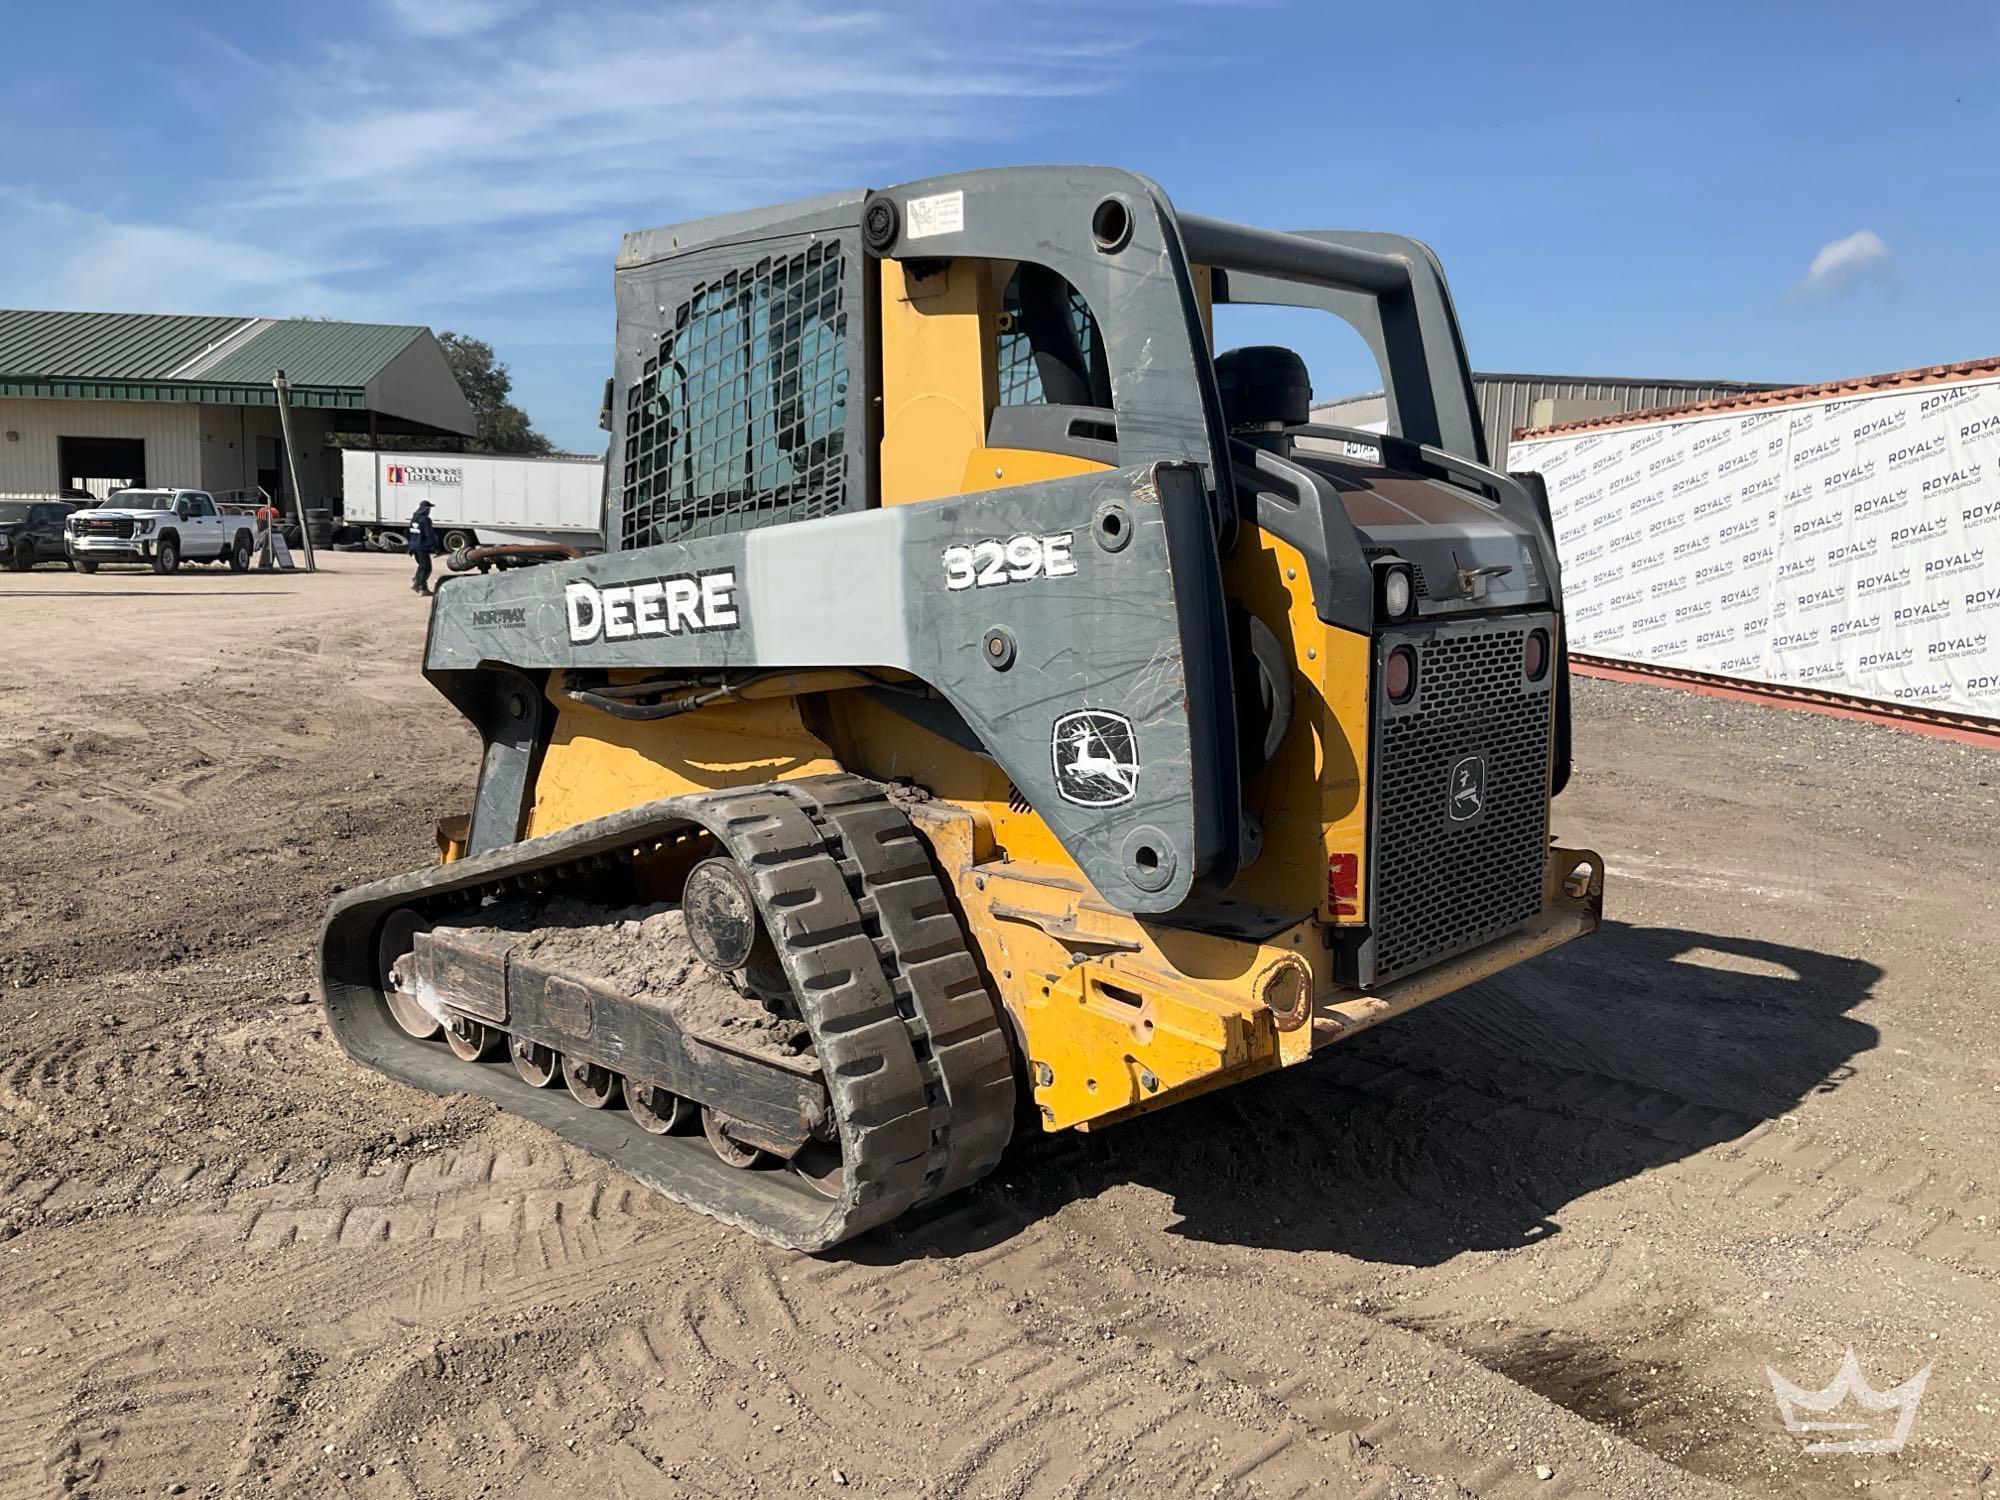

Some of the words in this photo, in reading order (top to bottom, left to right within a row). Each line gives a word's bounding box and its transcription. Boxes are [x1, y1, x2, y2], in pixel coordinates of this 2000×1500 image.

[1920, 387, 1967, 412] ROYAL
[1921, 403, 1953, 419] AUCTION
[1954, 392, 1980, 407] GROUP
[1853, 416, 1894, 439] ROYAL
[1961, 416, 2000, 438] ROYA
[1630, 434, 1656, 451] ROYAL
[1692, 432, 1722, 452] ROYAL
[1962, 430, 1995, 446] AUCTION
[1793, 441, 1830, 463] ROYAL
[1888, 441, 1933, 464] ROYAL
[1889, 456, 1920, 472] AUCTION
[1920, 447, 1946, 462] GROUP
[1592, 455, 1617, 470] ROYAL
[1649, 455, 1675, 472] ROYAL
[1718, 454, 1749, 472] ROYAL
[1609, 475, 1634, 490] ROYAL
[1672, 477, 1701, 492] ROYAL
[1824, 466, 1863, 487] ROYAL
[1922, 469, 1968, 492] ROYAL
[1741, 478, 1774, 497] ROYAL
[1784, 489, 1803, 501] YAL
[1923, 485, 1955, 500] AUCTION
[1956, 477, 1982, 490] GROUP
[1574, 493, 1597, 507] ROYAL
[1630, 494, 1656, 510] ROYAL
[1693, 498, 1723, 515] ROYAL
[1854, 493, 1895, 515] ROYAL
[1855, 508, 1883, 521] AUCTION
[1884, 500, 1908, 515] GROUP
[1962, 501, 2000, 521] ROYA
[1592, 512, 1617, 527] ROYAL
[1649, 518, 1677, 533] ROYAL
[1793, 514, 1833, 535] ROYAL
[1963, 515, 1998, 529] AUCTION
[1720, 521, 1750, 538] ROYAL
[1891, 522, 1935, 542] ROYAL
[1922, 529, 1948, 541] GROUP
[1609, 533, 1634, 548] ROYAL
[1673, 538, 1702, 555] ROYAL
[1743, 547, 1774, 564] ROYAL
[1828, 541, 1866, 561] ROYAL
[1631, 555, 1657, 569] ROYAL
[1778, 561, 1805, 575] OYAL
[1925, 553, 1971, 573] ROYAL
[1593, 568, 1616, 583] ROYAL
[1695, 565, 1725, 579] ROYAL
[1926, 568, 1957, 581] AUCTION
[1958, 562, 1985, 573] GROUP
[1651, 578, 1679, 593] ROYAL
[1857, 571, 1899, 590] ROYAL
[1720, 588, 1752, 604] ROYAL
[1798, 589, 1835, 605] ROYAL
[1858, 586, 1887, 598] AUCTION
[1888, 580, 1911, 591] GROUP
[565, 568, 738, 644] DEERE
[1610, 592, 1635, 606] ROYAL
[1575, 605, 1597, 617] ROYAL
[1675, 603, 1703, 617] ROYAL
[1894, 603, 1937, 621] ROYAL
[1632, 615, 1658, 629] ROYAL
[1744, 617, 1769, 632] ROYA
[1830, 618, 1869, 635] ROYAL
[1895, 617, 1925, 628] AUCTION
[1925, 612, 1951, 623] GROUP
[1593, 627, 1617, 640] ROYAL
[1696, 629, 1726, 643] ROYAL
[1772, 632, 1809, 647] ROYAL
[1651, 640, 1678, 654] ROYAL
[1928, 637, 1974, 655] ROYAL
[1860, 650, 1901, 666] ROYAL
[1929, 651, 1960, 663] AUCTION
[1961, 647, 1988, 657] GROUP
[1720, 656, 1752, 671] ROYAL
[1800, 661, 1836, 679] ROYAL
[1894, 684, 1938, 699] ROYAL
[1967, 688, 2000, 698] AUCTIO
